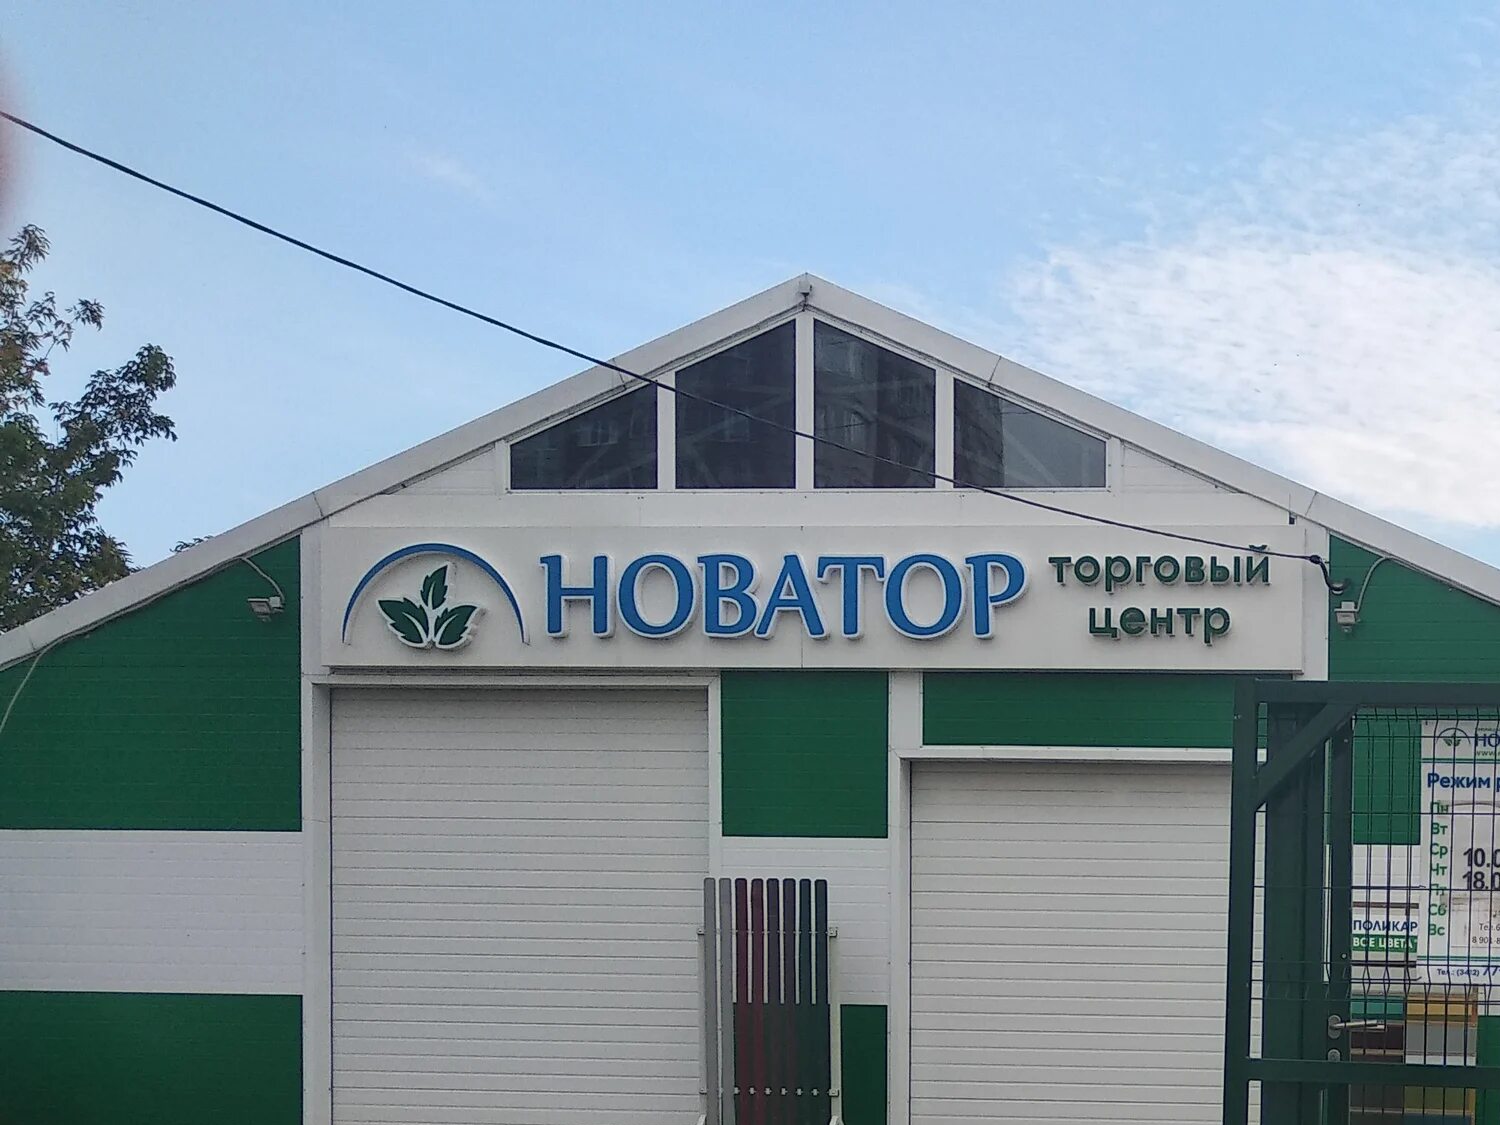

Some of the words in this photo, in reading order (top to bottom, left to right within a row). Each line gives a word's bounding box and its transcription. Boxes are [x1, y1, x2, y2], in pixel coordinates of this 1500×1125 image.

[1048, 546, 1271, 592] торговый
[540, 553, 1031, 642] НОВАТОР
[1087, 602, 1232, 646] центр
[1427, 773, 1491, 788] Режим
[1430, 801, 1449, 813] Пн
[1431, 823, 1448, 835] Вт
[1430, 843, 1448, 856] Ср
[1430, 863, 1447, 876] Чт
[1429, 903, 1447, 916] Сб
[1428, 924, 1445, 936] Вс
[1353, 937, 1375, 947] ВСЕ
